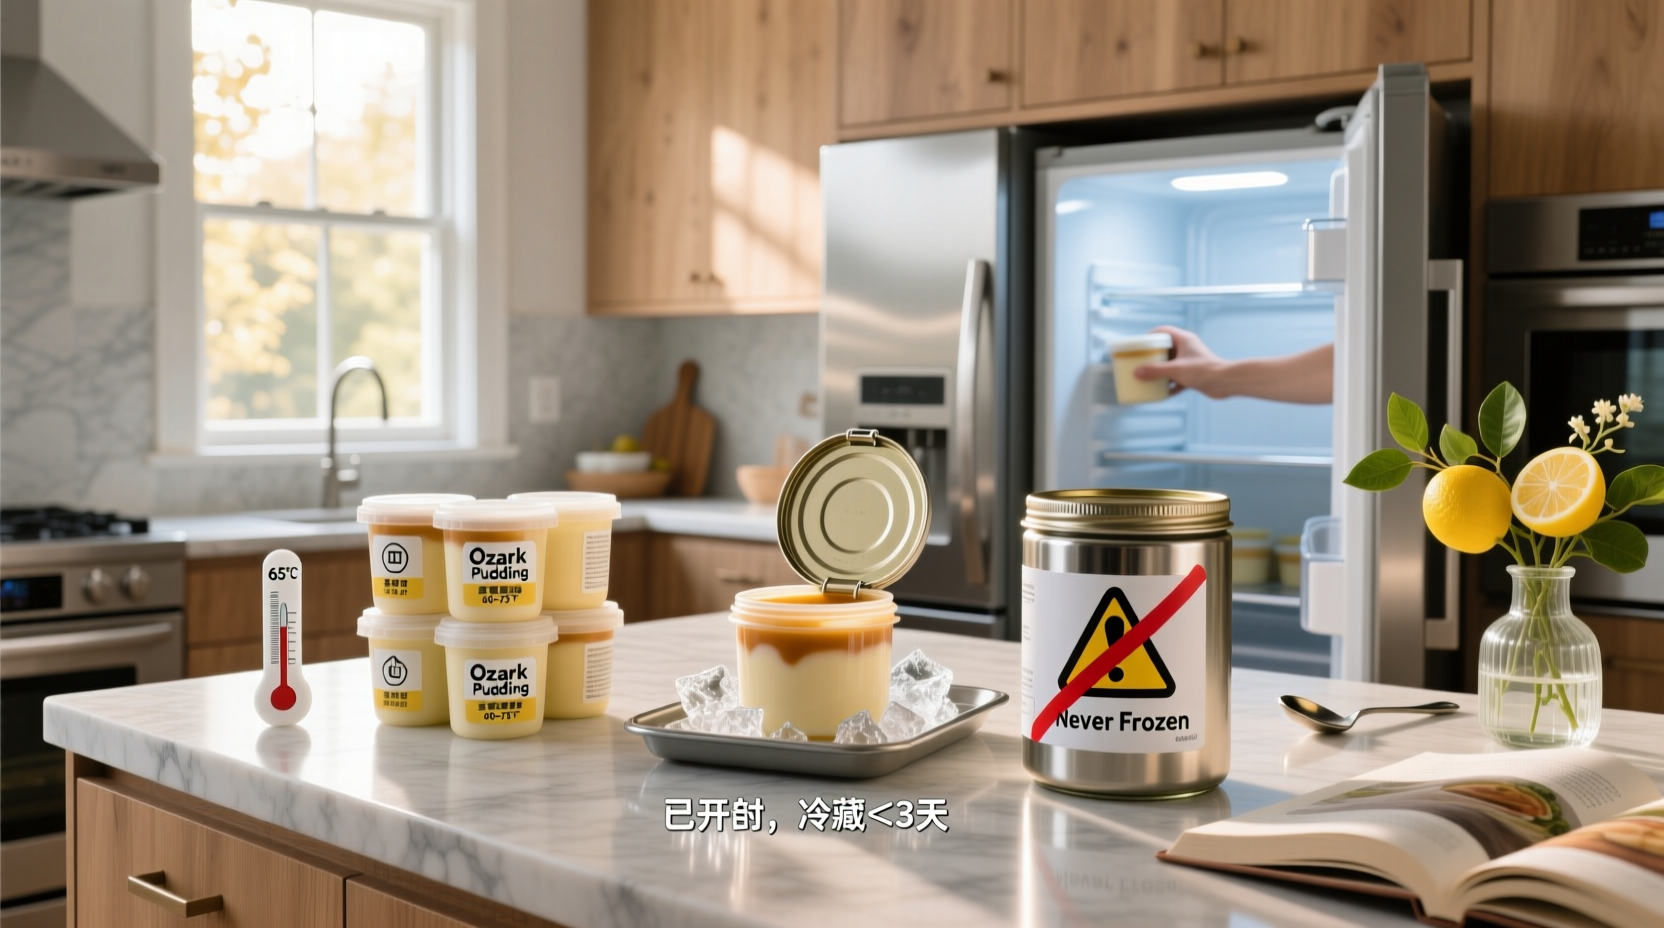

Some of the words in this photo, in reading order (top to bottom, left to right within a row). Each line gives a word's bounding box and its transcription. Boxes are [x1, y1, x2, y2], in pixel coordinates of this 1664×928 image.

[469, 547, 527, 565] Ozark
[471, 566, 529, 581] Pudding
[470, 663, 528, 681] Ozark
[1056, 709, 1114, 731] Never
[1119, 711, 1189, 732] Frozen
